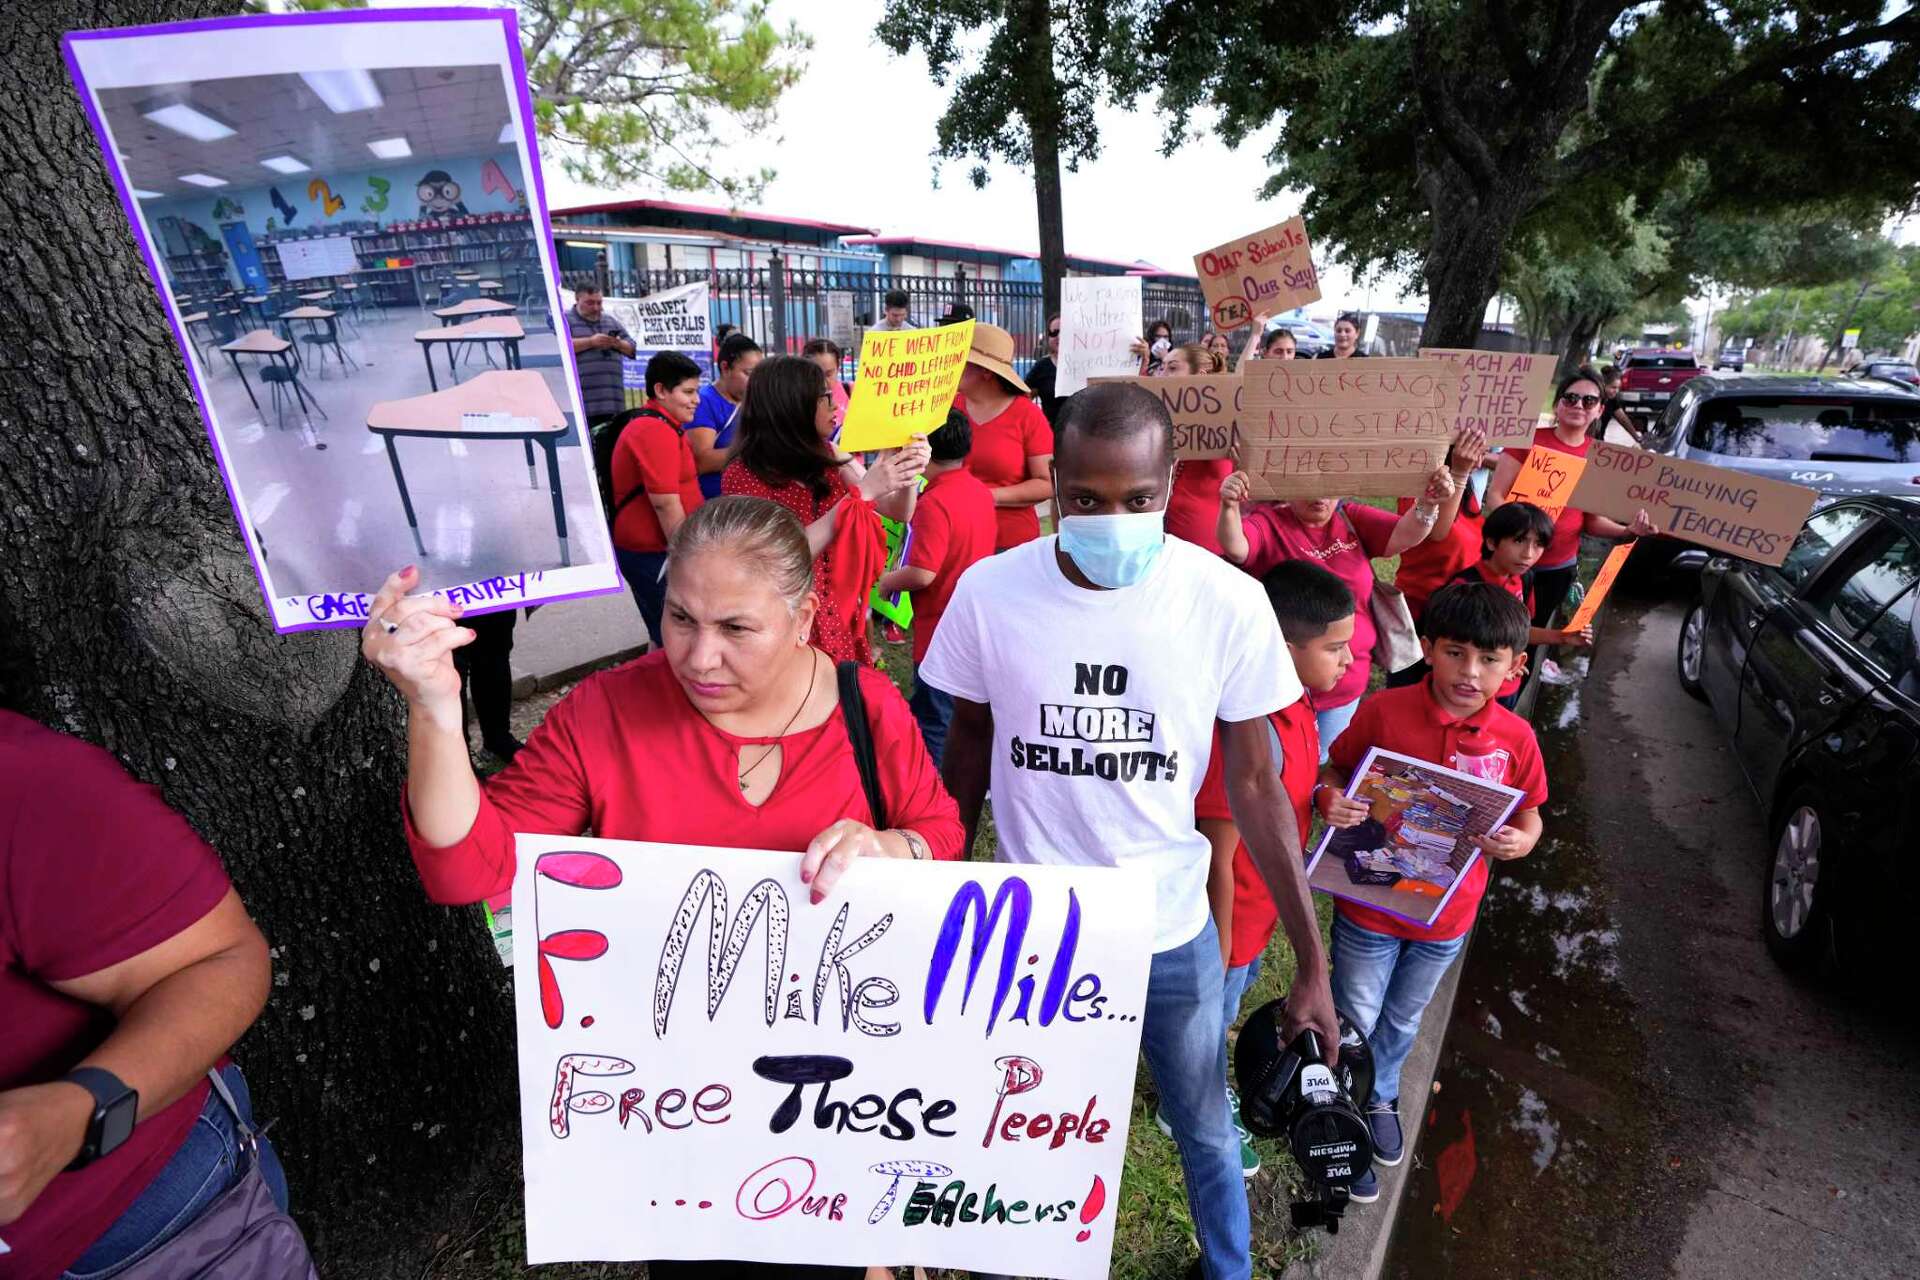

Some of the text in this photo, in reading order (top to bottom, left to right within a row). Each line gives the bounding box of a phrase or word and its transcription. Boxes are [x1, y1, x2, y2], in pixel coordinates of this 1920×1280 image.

[1247, 228, 1304, 264] Schools
[639, 299, 687, 316] PROJECT
[1216, 303, 1248, 322] TEA
[644, 334, 704, 345] MIDDLE SCHOOL
[906, 335, 941, 355] WENT
[945, 329, 968, 348] FROM
[1073, 328, 1121, 351] NOT
[888, 361, 917, 378] CHILD
[873, 381, 888, 396] TO
[899, 378, 930, 396] EVERY
[1268, 366, 1447, 408] QUEREMOS
[1477, 375, 1524, 395] THE
[1162, 386, 1221, 414] NOS
[1474, 394, 1528, 415] THEY
[1492, 417, 1538, 438] BEST
[1531, 452, 1556, 473] WE
[1627, 484, 1671, 507] OUR
[1074, 663, 1128, 696] NO
[1043, 706, 1153, 742] MORE
[1010, 735, 1178, 783] $ELLOUT$
[752, 1055, 957, 1140] These
[981, 1056, 1110, 1148] People
[1326, 1166, 1352, 1178] PYLE
